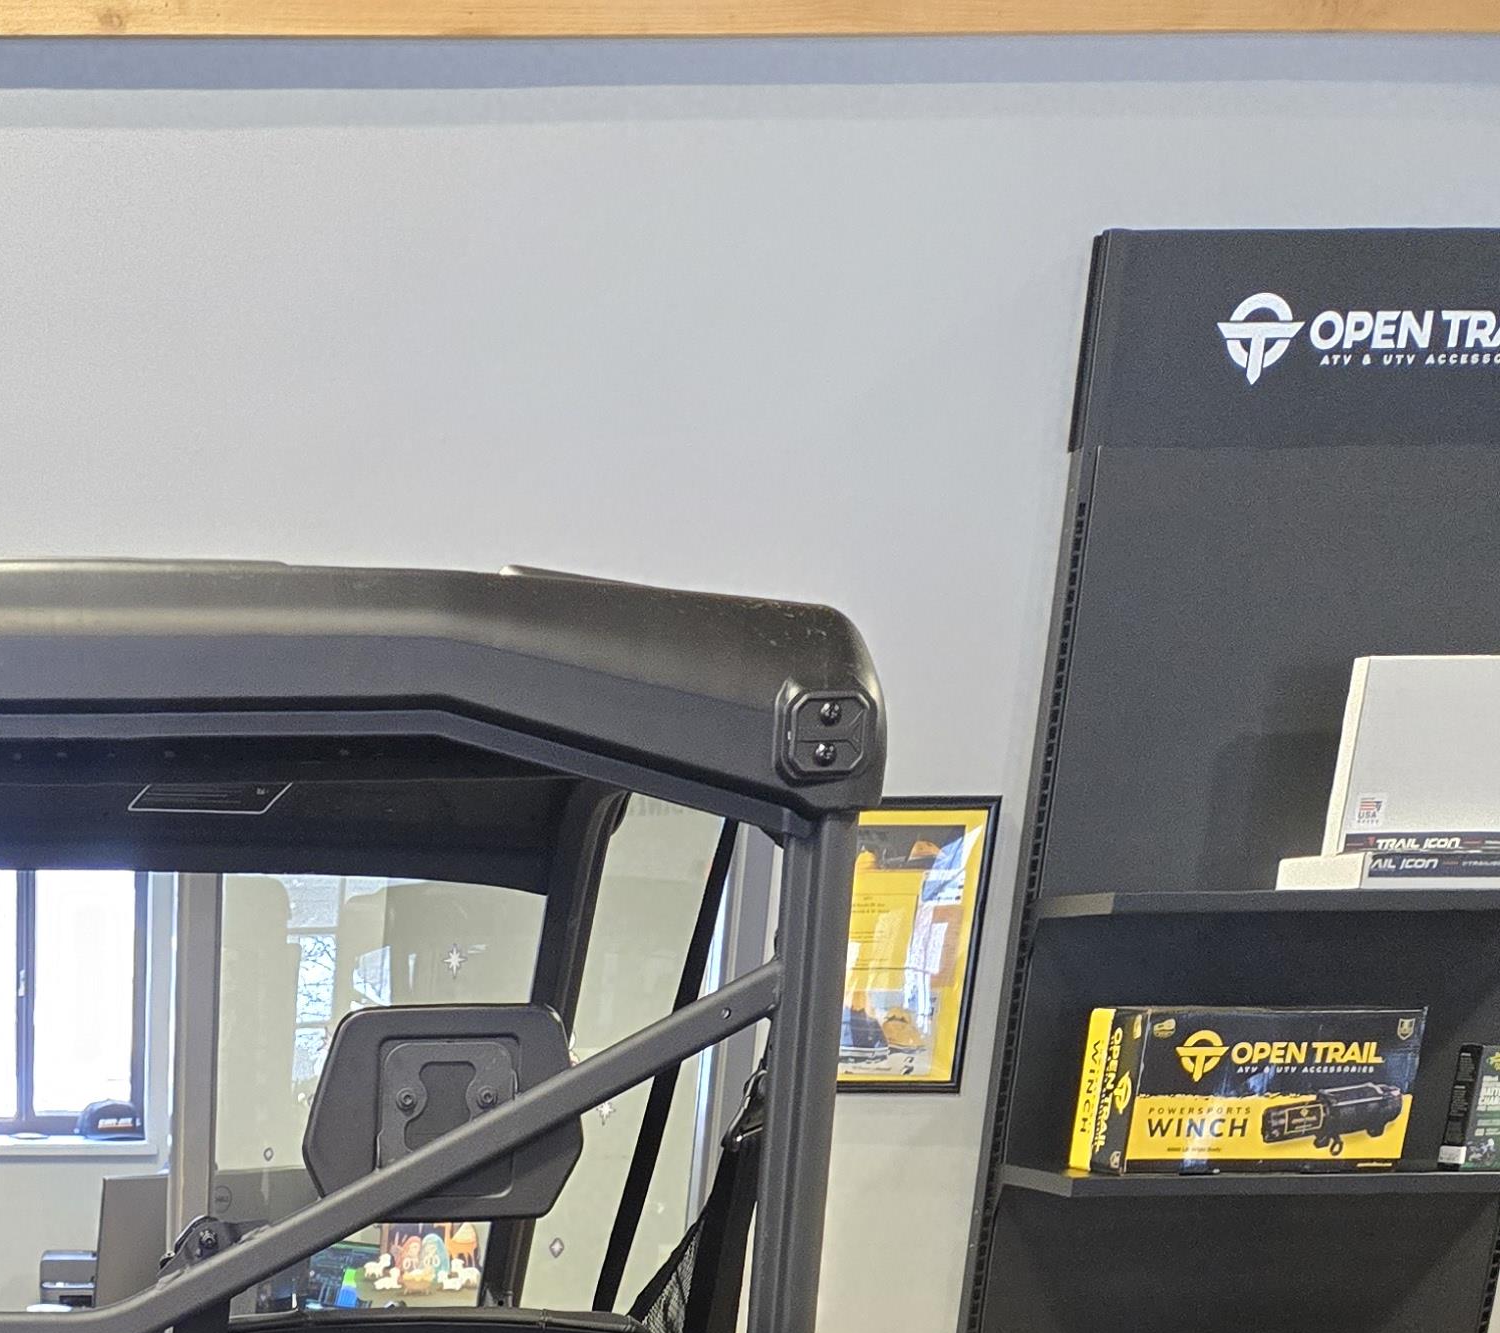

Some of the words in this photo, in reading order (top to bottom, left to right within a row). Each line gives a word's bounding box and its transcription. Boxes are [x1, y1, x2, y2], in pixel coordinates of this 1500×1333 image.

[1310, 310, 1434, 350] OPEN
[1320, 353, 1352, 366] ATV
[1362, 353, 1372, 366] &
[1383, 353, 1416, 366] UTV
[1357, 811, 1377, 819] USA
[1375, 838, 1420, 850] TRAIL
[1423, 837, 1461, 849] ICON
[1400, 858, 1439, 870] ICON
[1106, 1027, 1124, 1090] OPEN
[1231, 1041, 1308, 1065] OPEN
[1312, 1041, 1386, 1064] TRAIL
[1236, 1066, 1258, 1074] ATV
[1276, 1066, 1298, 1074] UTV
[1079, 1040, 1101, 1133] WINCH
[1148, 1106, 1251, 1115] POWERSPORTS
[1147, 1117, 1248, 1138] WINCH
